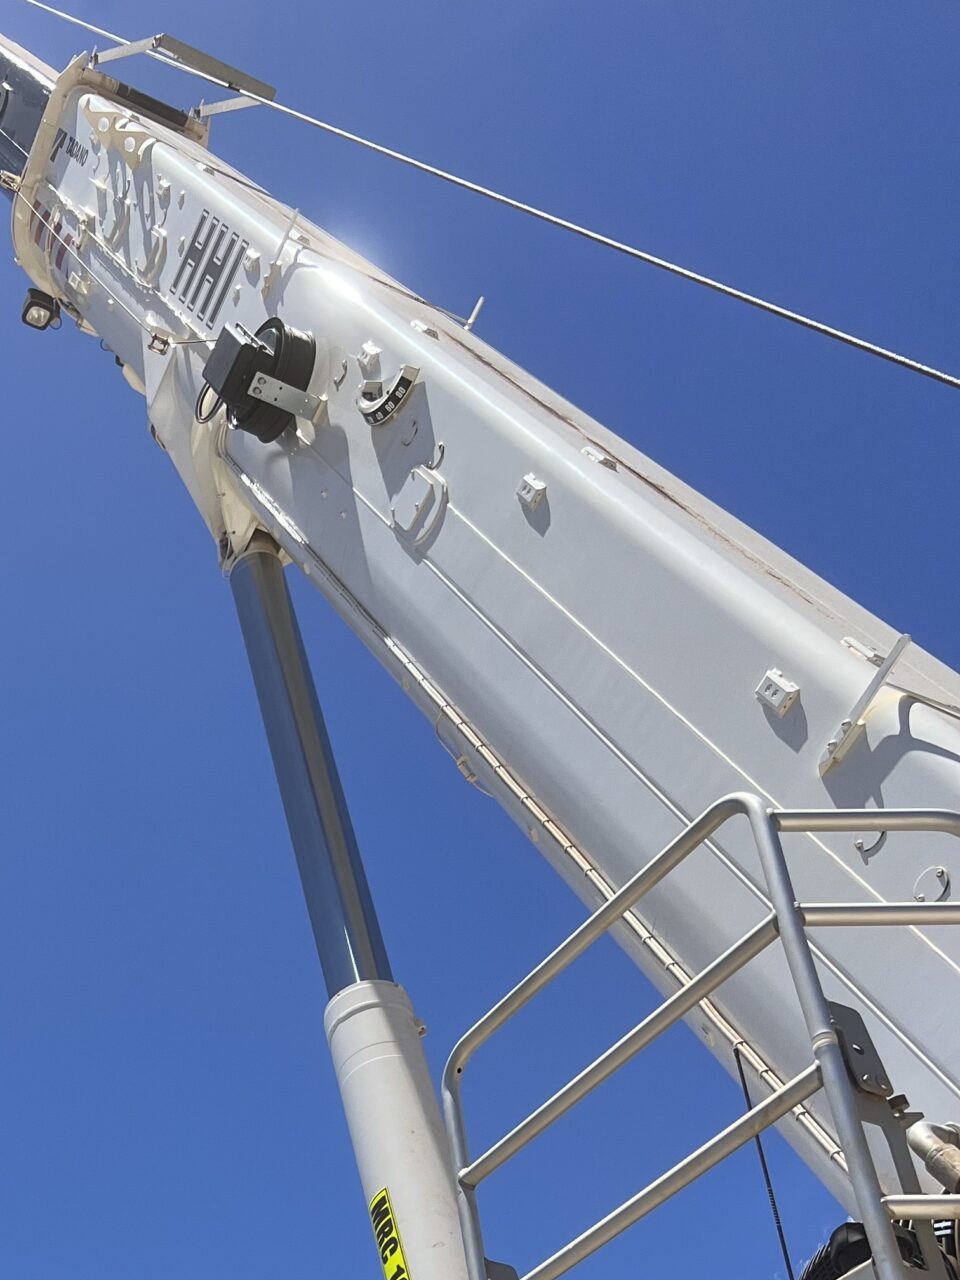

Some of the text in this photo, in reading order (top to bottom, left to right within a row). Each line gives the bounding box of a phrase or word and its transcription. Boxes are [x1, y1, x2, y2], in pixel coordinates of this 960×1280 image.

[169, 208, 250, 331] HHI
[384, 401, 395, 412] 60
[395, 386, 406, 399] 80
[371, 1195, 398, 1265] MRC
